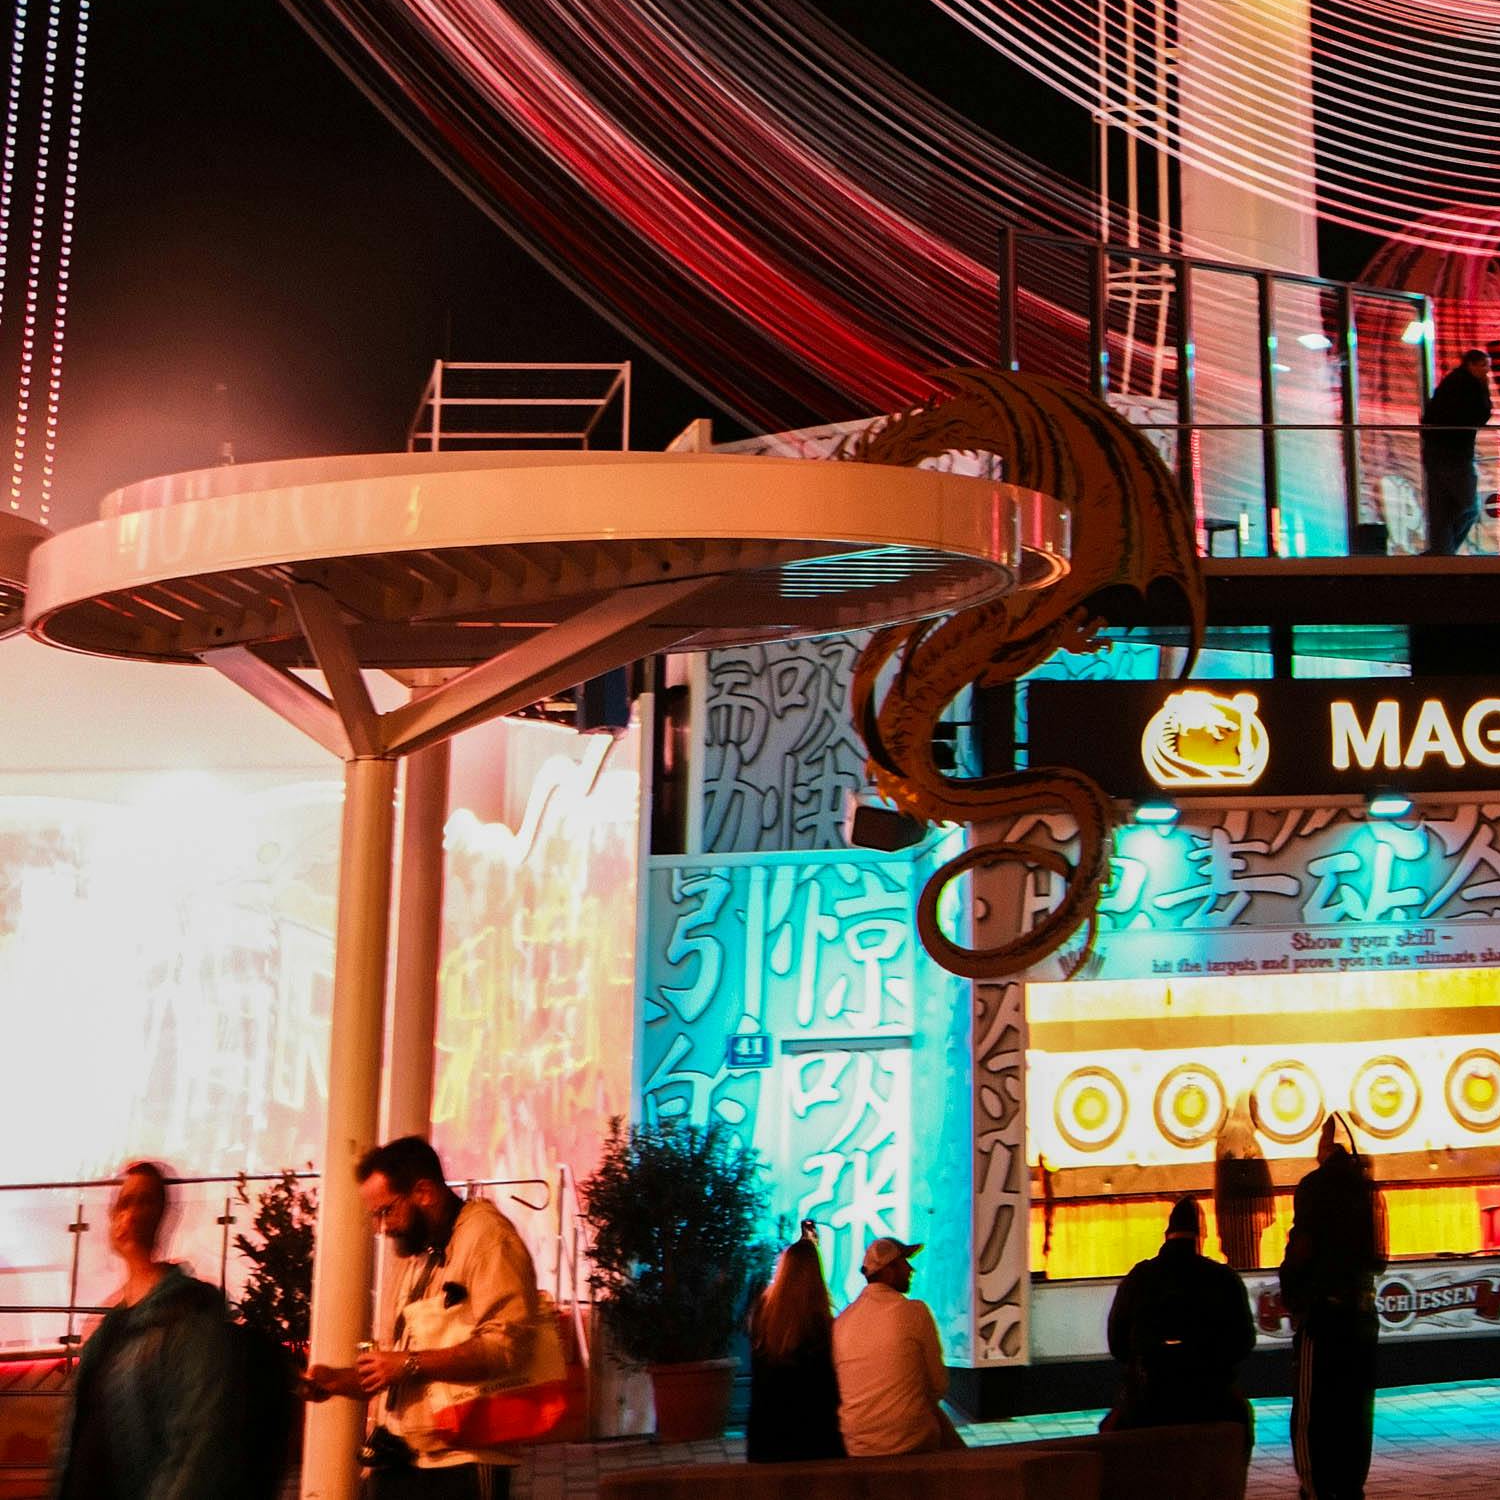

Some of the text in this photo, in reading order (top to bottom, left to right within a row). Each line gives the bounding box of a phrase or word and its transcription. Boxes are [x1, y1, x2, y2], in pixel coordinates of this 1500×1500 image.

[1291, 932, 1344, 952] Show
[1350, 935, 1389, 953] your
[1396, 928, 1436, 946] skill
[1152, 958, 1173, 973] hit
[1177, 957, 1202, 972] the
[1206, 957, 1258, 976] targets
[1262, 954, 1290, 970] and
[1293, 957, 1334, 973] prove
[1339, 955, 1383, 972] you're
[1388, 951, 1410, 965] the
[1416, 949, 1476, 965] ultimate
[734, 1036, 764, 1056] 41
[1374, 1284, 1479, 1313] SCHIESSEN
